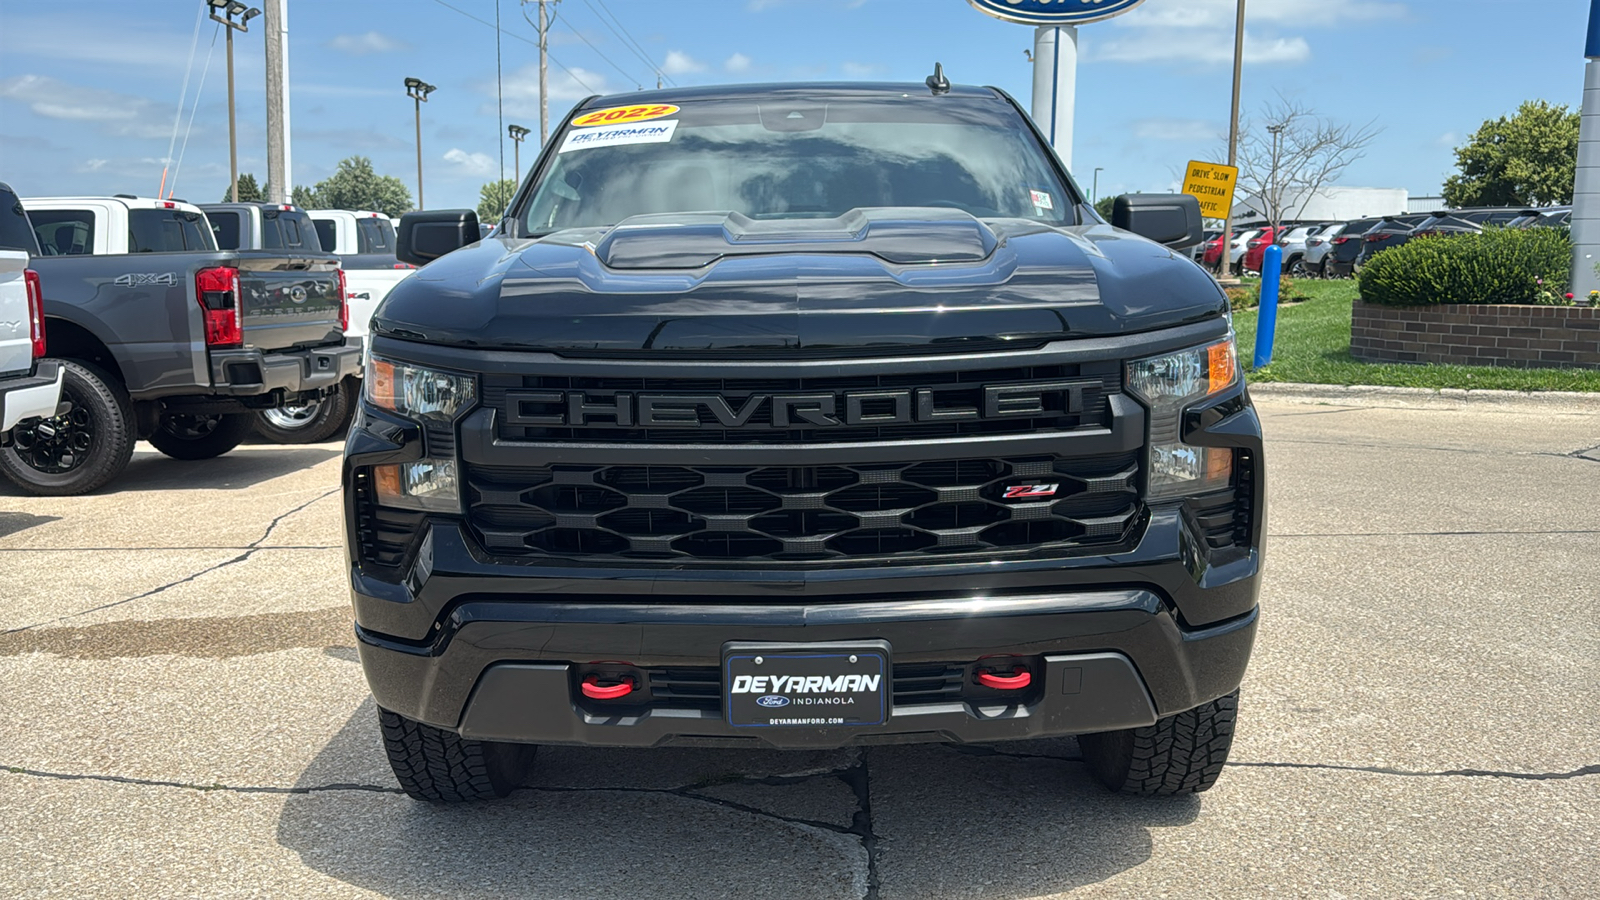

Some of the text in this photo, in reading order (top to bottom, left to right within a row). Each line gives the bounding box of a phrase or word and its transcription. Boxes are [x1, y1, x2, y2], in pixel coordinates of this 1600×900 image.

[580, 106, 670, 124] 2022
[572, 126, 669, 141] DEYARMAN
[1192, 168, 1229, 181] DRIVE SLOW
[1189, 183, 1226, 196] PEDESTRIAN
[1199, 201, 1218, 211] AFFIC
[505, 380, 1103, 428] CHEVROLET
[1002, 483, 1060, 498] Z71
[731, 674, 881, 694] DEYARMAN
[793, 697, 855, 705] INDIANOLA
[769, 717, 844, 725] DEYARMANFORD.COM
